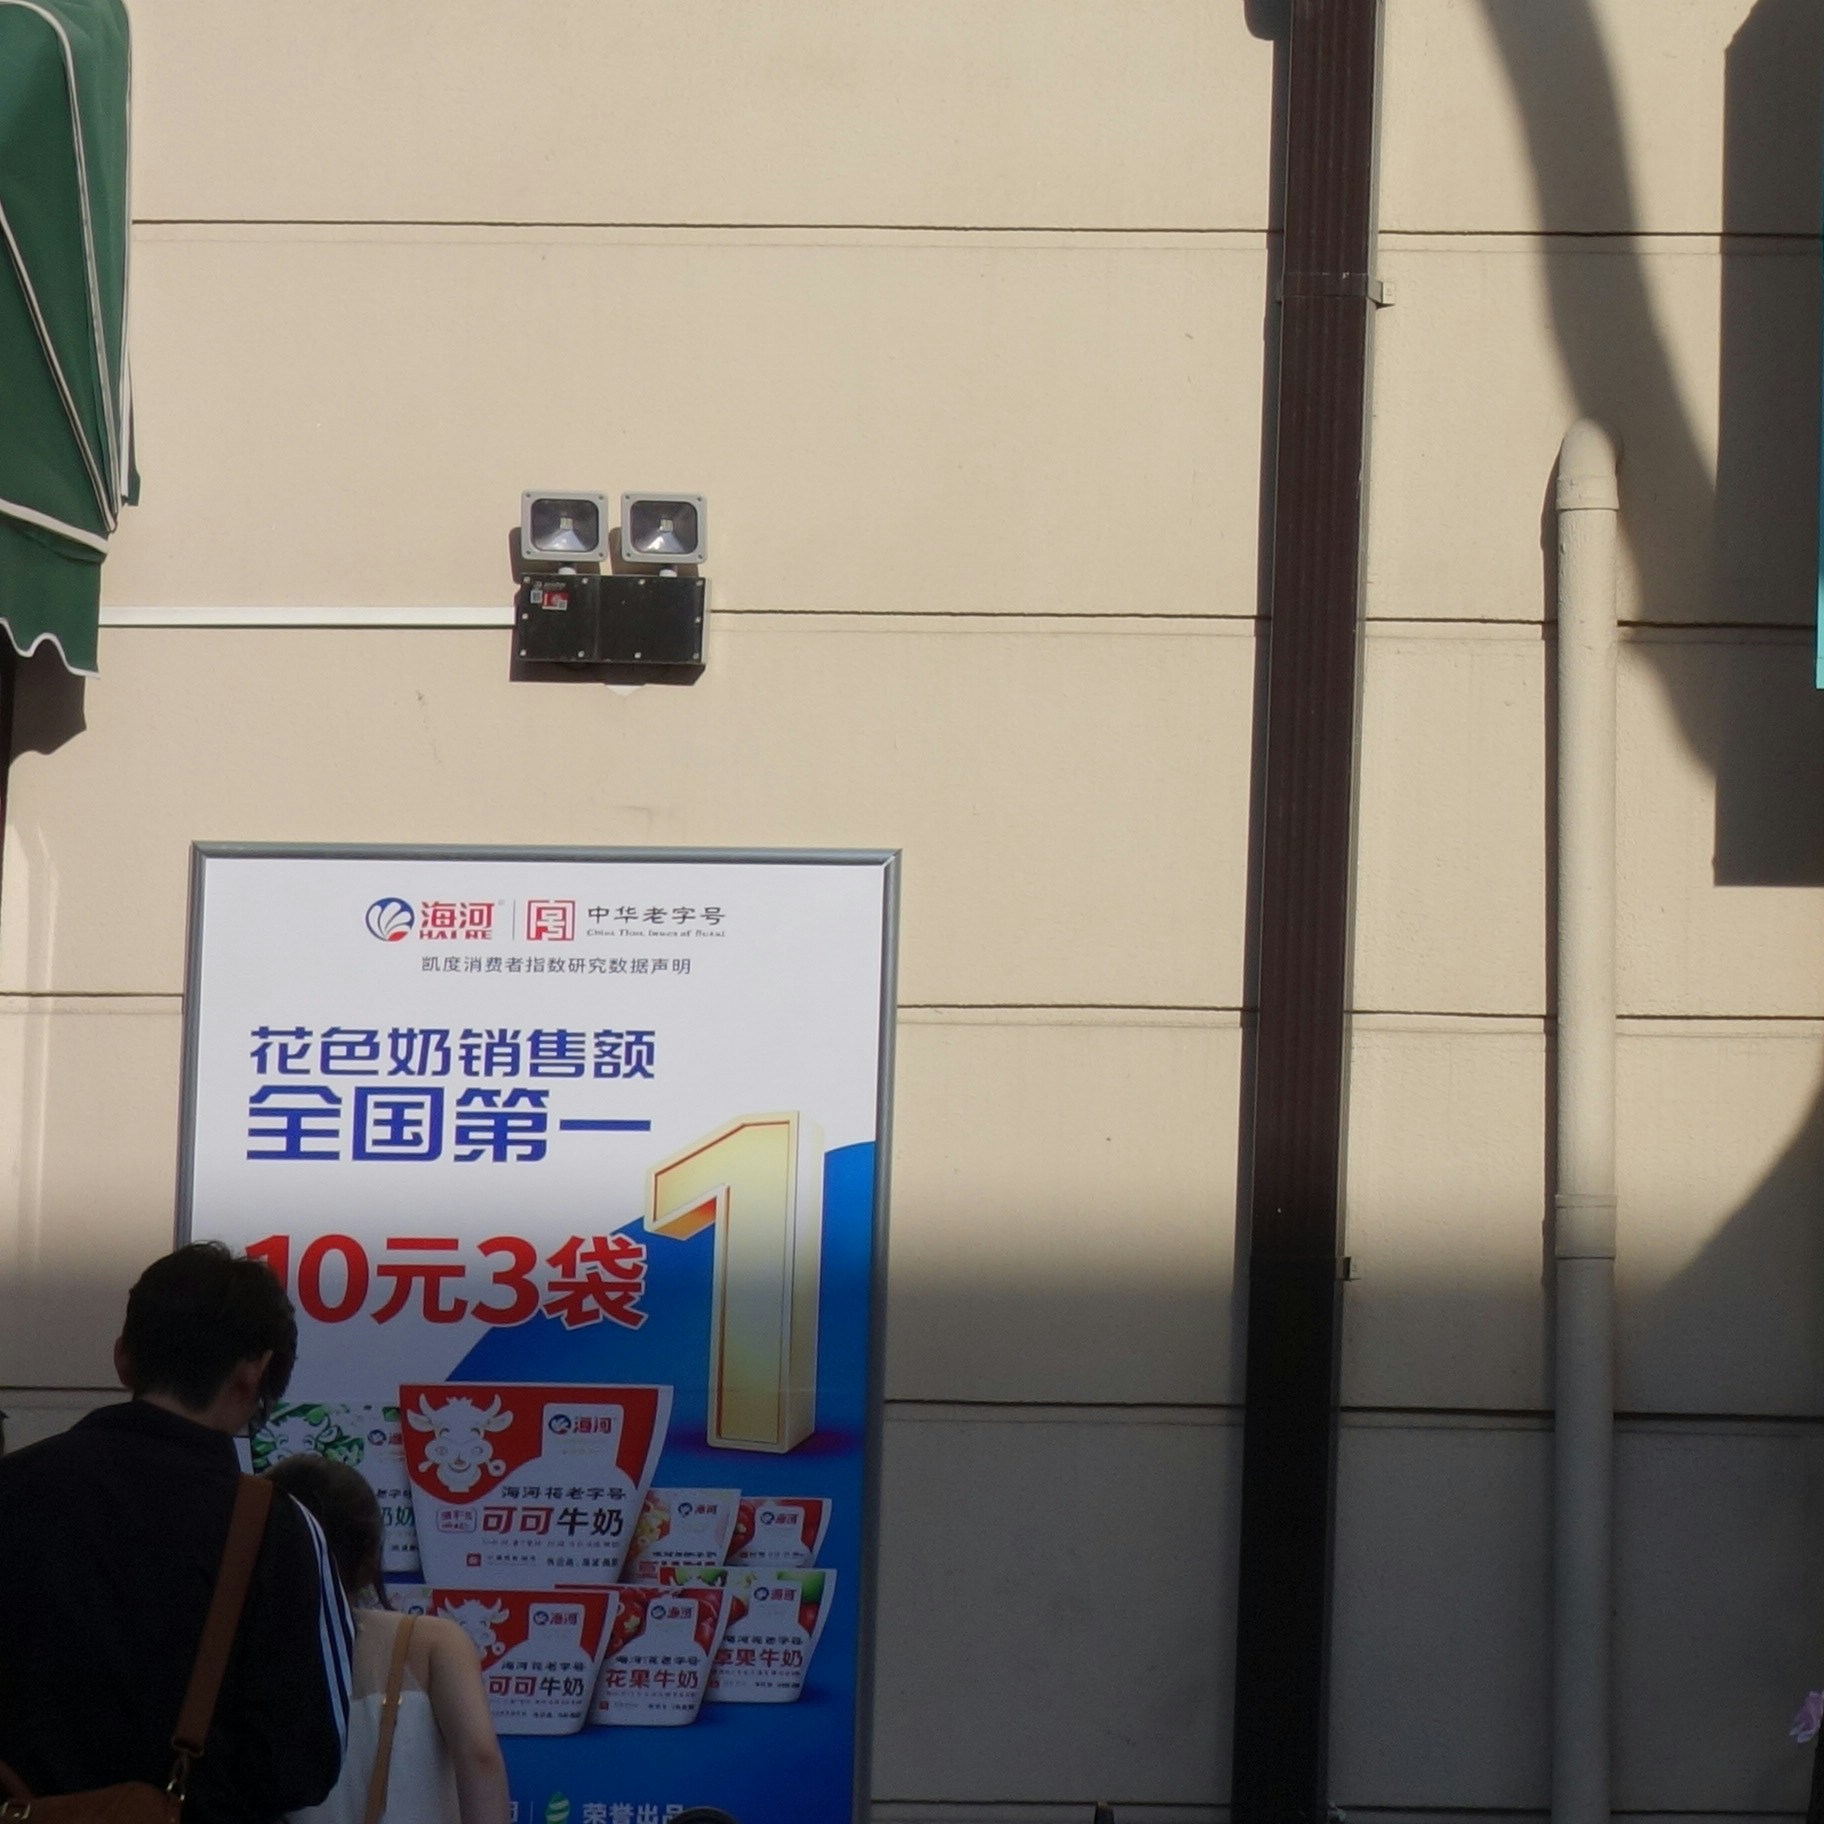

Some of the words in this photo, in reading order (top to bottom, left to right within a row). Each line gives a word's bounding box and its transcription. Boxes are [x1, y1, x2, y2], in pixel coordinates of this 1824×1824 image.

[420, 900, 494, 928] 海河
[587, 905, 727, 925] 中华老字号
[421, 955, 692, 975] 凯度消费者指数研究数据声明
[249, 1026, 656, 1079] 花色奶销售额
[246, 1085, 652, 1163] 全国第一
[482, 1506, 624, 1537] 可可牛奶
[489, 1675, 585, 1697] 可可牛奶
